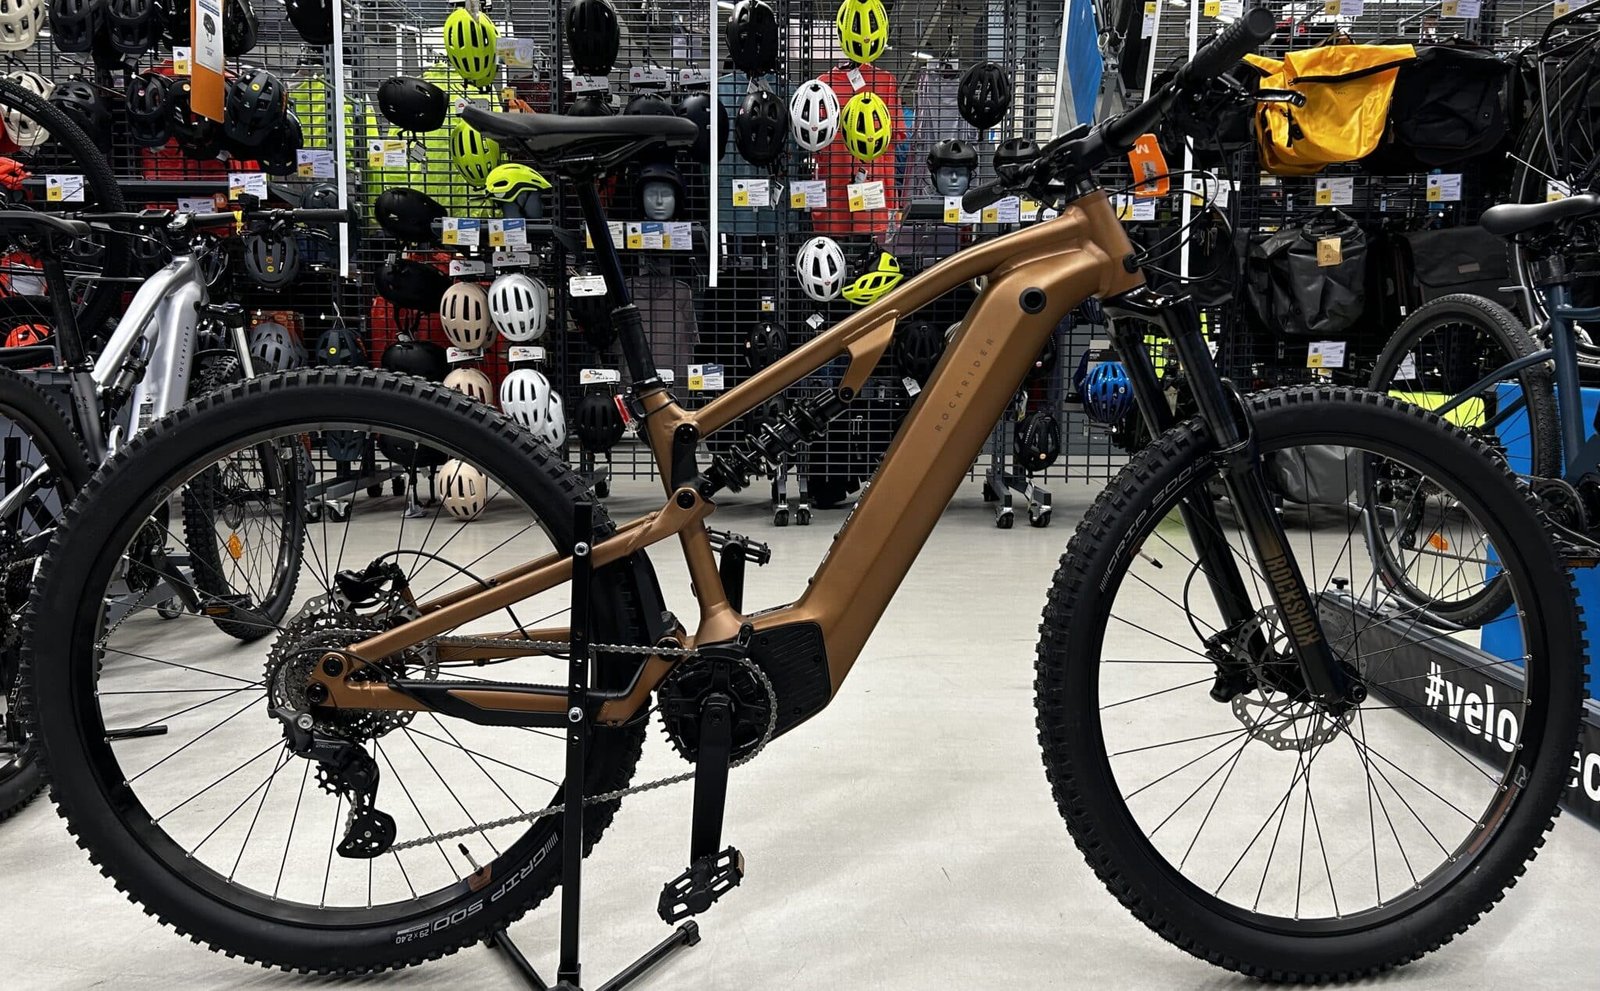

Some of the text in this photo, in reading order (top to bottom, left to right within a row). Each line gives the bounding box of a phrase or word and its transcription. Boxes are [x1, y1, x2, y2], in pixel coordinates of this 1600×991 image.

[178, 326, 190, 378] ROCKRIDER
[934, 338, 995, 432] ROCKRIDER
[1107, 466, 1191, 575] GRIP 500
[1264, 554, 1321, 647] ROCKSHOX
[491, 846, 547, 902] GRIP
[419, 928, 429, 938] 29
[433, 899, 483, 932] 500
